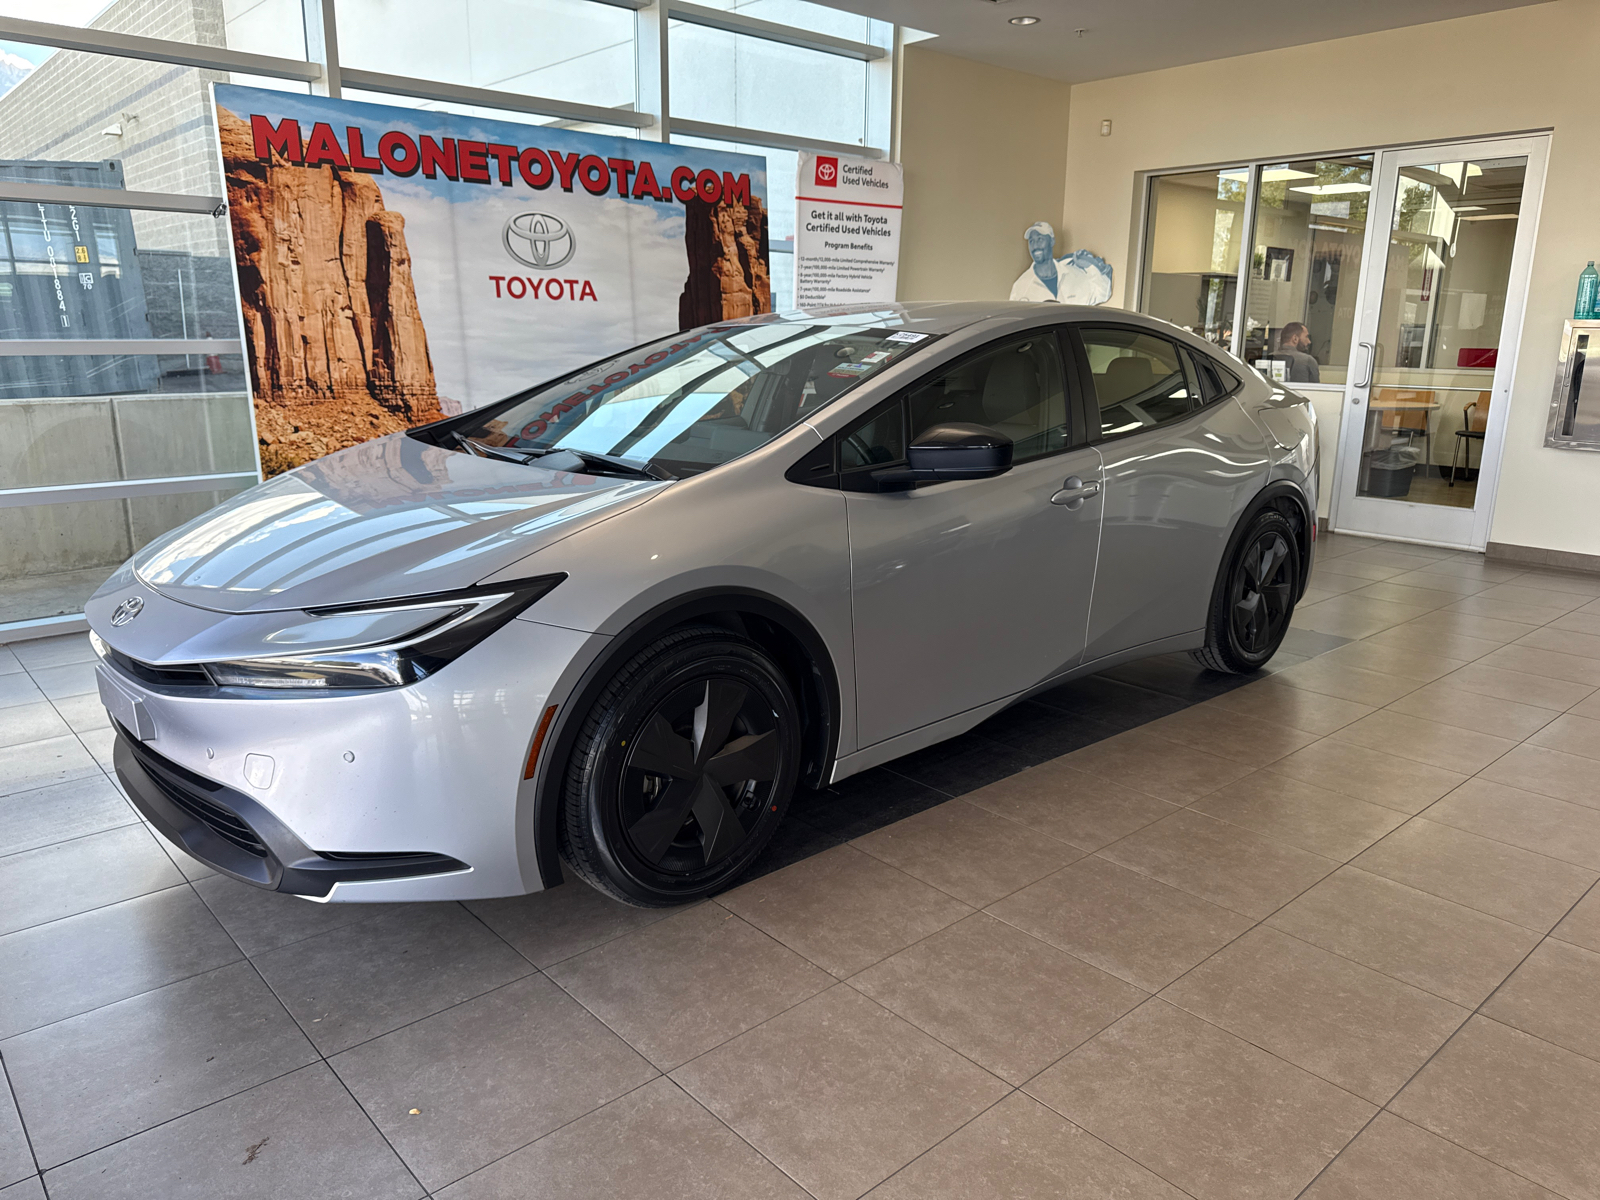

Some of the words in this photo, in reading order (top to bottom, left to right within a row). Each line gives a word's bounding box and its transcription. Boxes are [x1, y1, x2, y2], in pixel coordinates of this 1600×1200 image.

[250, 114, 752, 206] MALONETOYOTA.COM
[842, 164, 873, 176] Certified
[842, 176, 860, 186] Used
[861, 178, 889, 189] Vehicles
[811, 210, 826, 220] Get
[827, 211, 833, 220] it
[834, 212, 844, 222] all
[845, 213, 862, 223] with
[863, 215, 888, 225] Toyota
[806, 222, 840, 234] Certified
[841, 225, 861, 235] Used
[861, 226, 891, 237] Vehicles
[824, 241, 849, 251] Program
[850, 242, 873, 251] Benefits
[488, 274, 599, 302] TOYOTA
